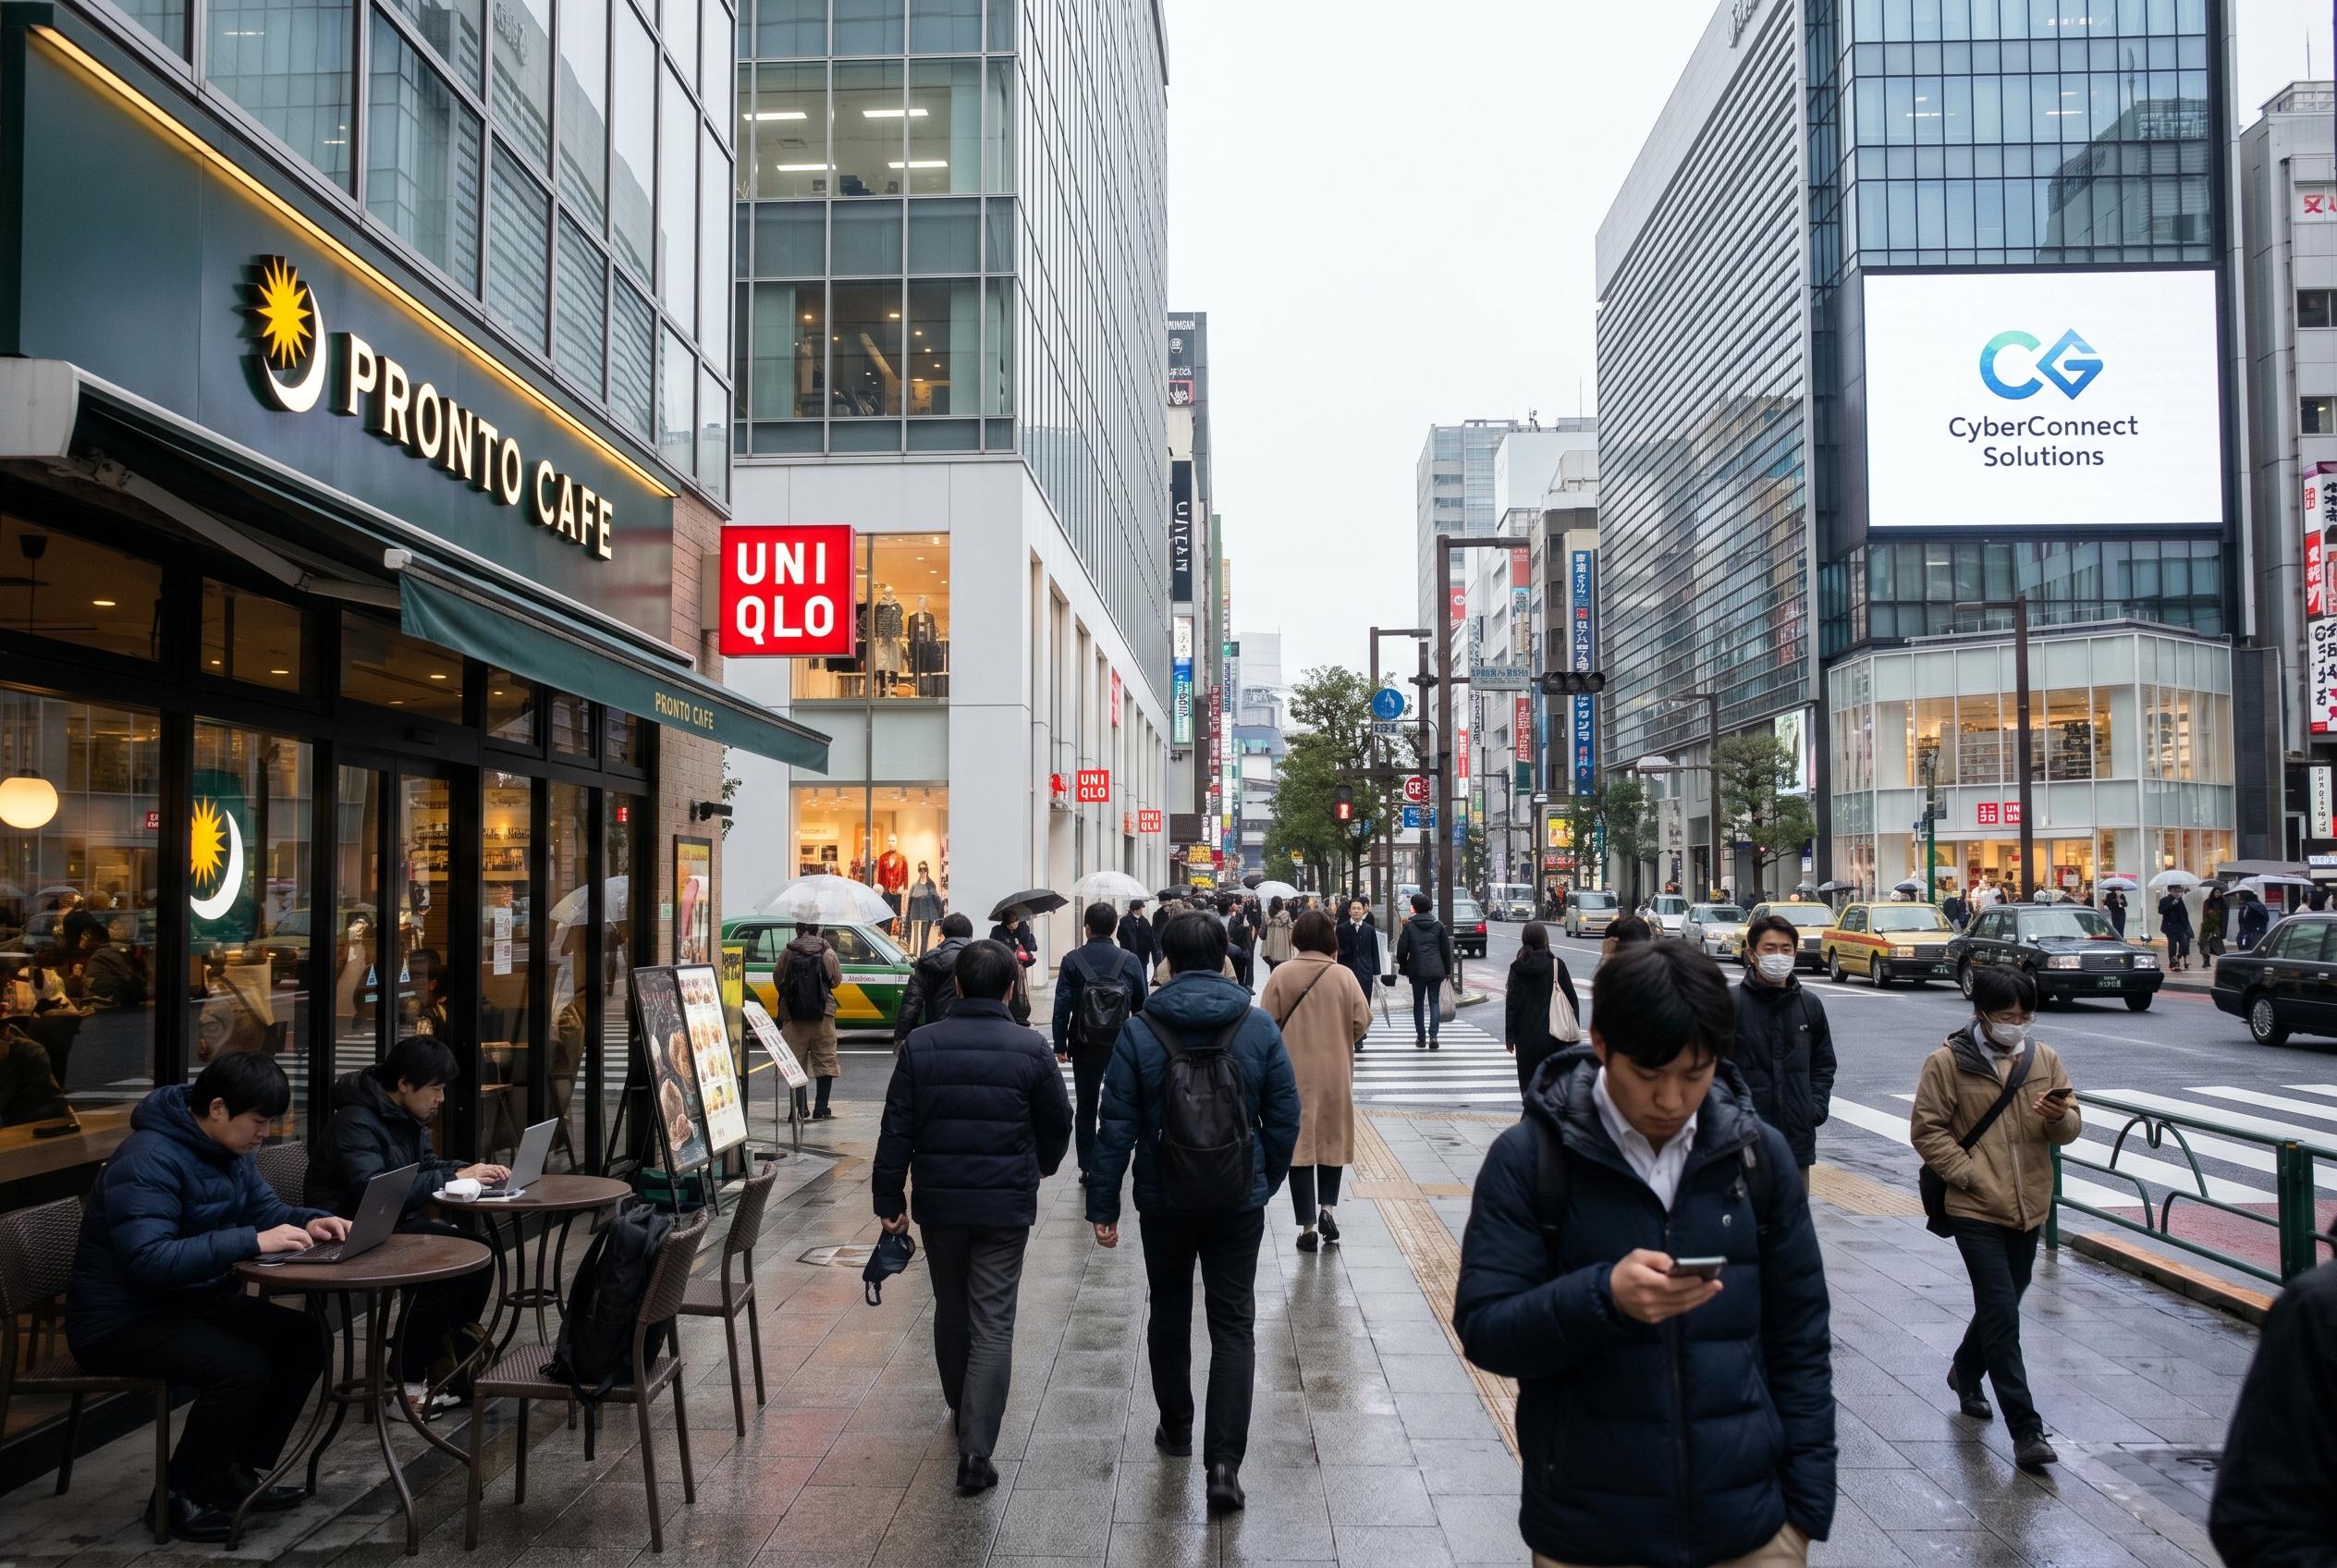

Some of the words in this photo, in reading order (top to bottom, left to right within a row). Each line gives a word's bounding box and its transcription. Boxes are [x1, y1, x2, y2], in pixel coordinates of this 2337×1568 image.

[1949, 415, 2139, 444] CyberConnect
[346, 332, 523, 506] PRONTO
[535, 459, 614, 561] CAFE
[1983, 445, 2105, 467] Solutions
[737, 542, 826, 585] UNI
[736, 594, 835, 645] QLO
[655, 692, 691, 722] PRONTO
[692, 706, 715, 730] CAFE
[1081, 774, 1105, 785] UNI
[1081, 787, 1106, 800] QLO
[2006, 804, 2020, 814] UN
